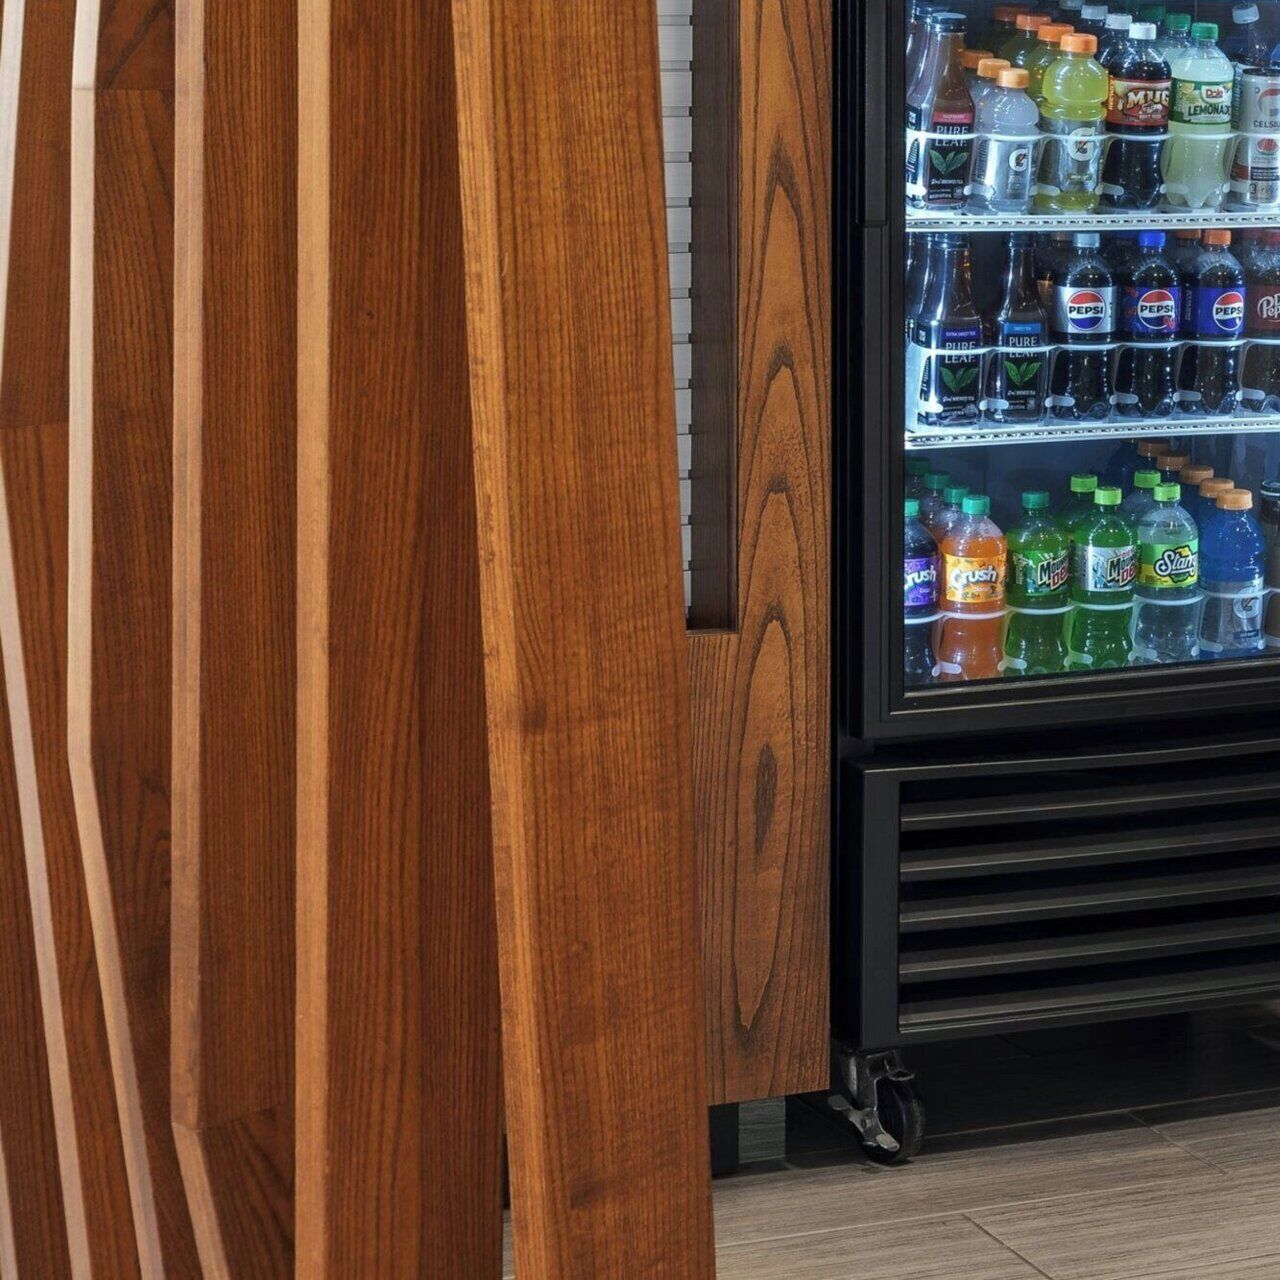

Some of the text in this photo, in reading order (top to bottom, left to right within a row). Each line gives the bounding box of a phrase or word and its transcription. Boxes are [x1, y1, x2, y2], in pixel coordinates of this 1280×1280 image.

[1126, 90, 1170, 108] MUG
[1068, 305, 1104, 315] PEPSI
[1140, 305, 1174, 315] PEPSI
[1009, 336, 1038, 347] PURE
[950, 566, 997, 587] Crush
